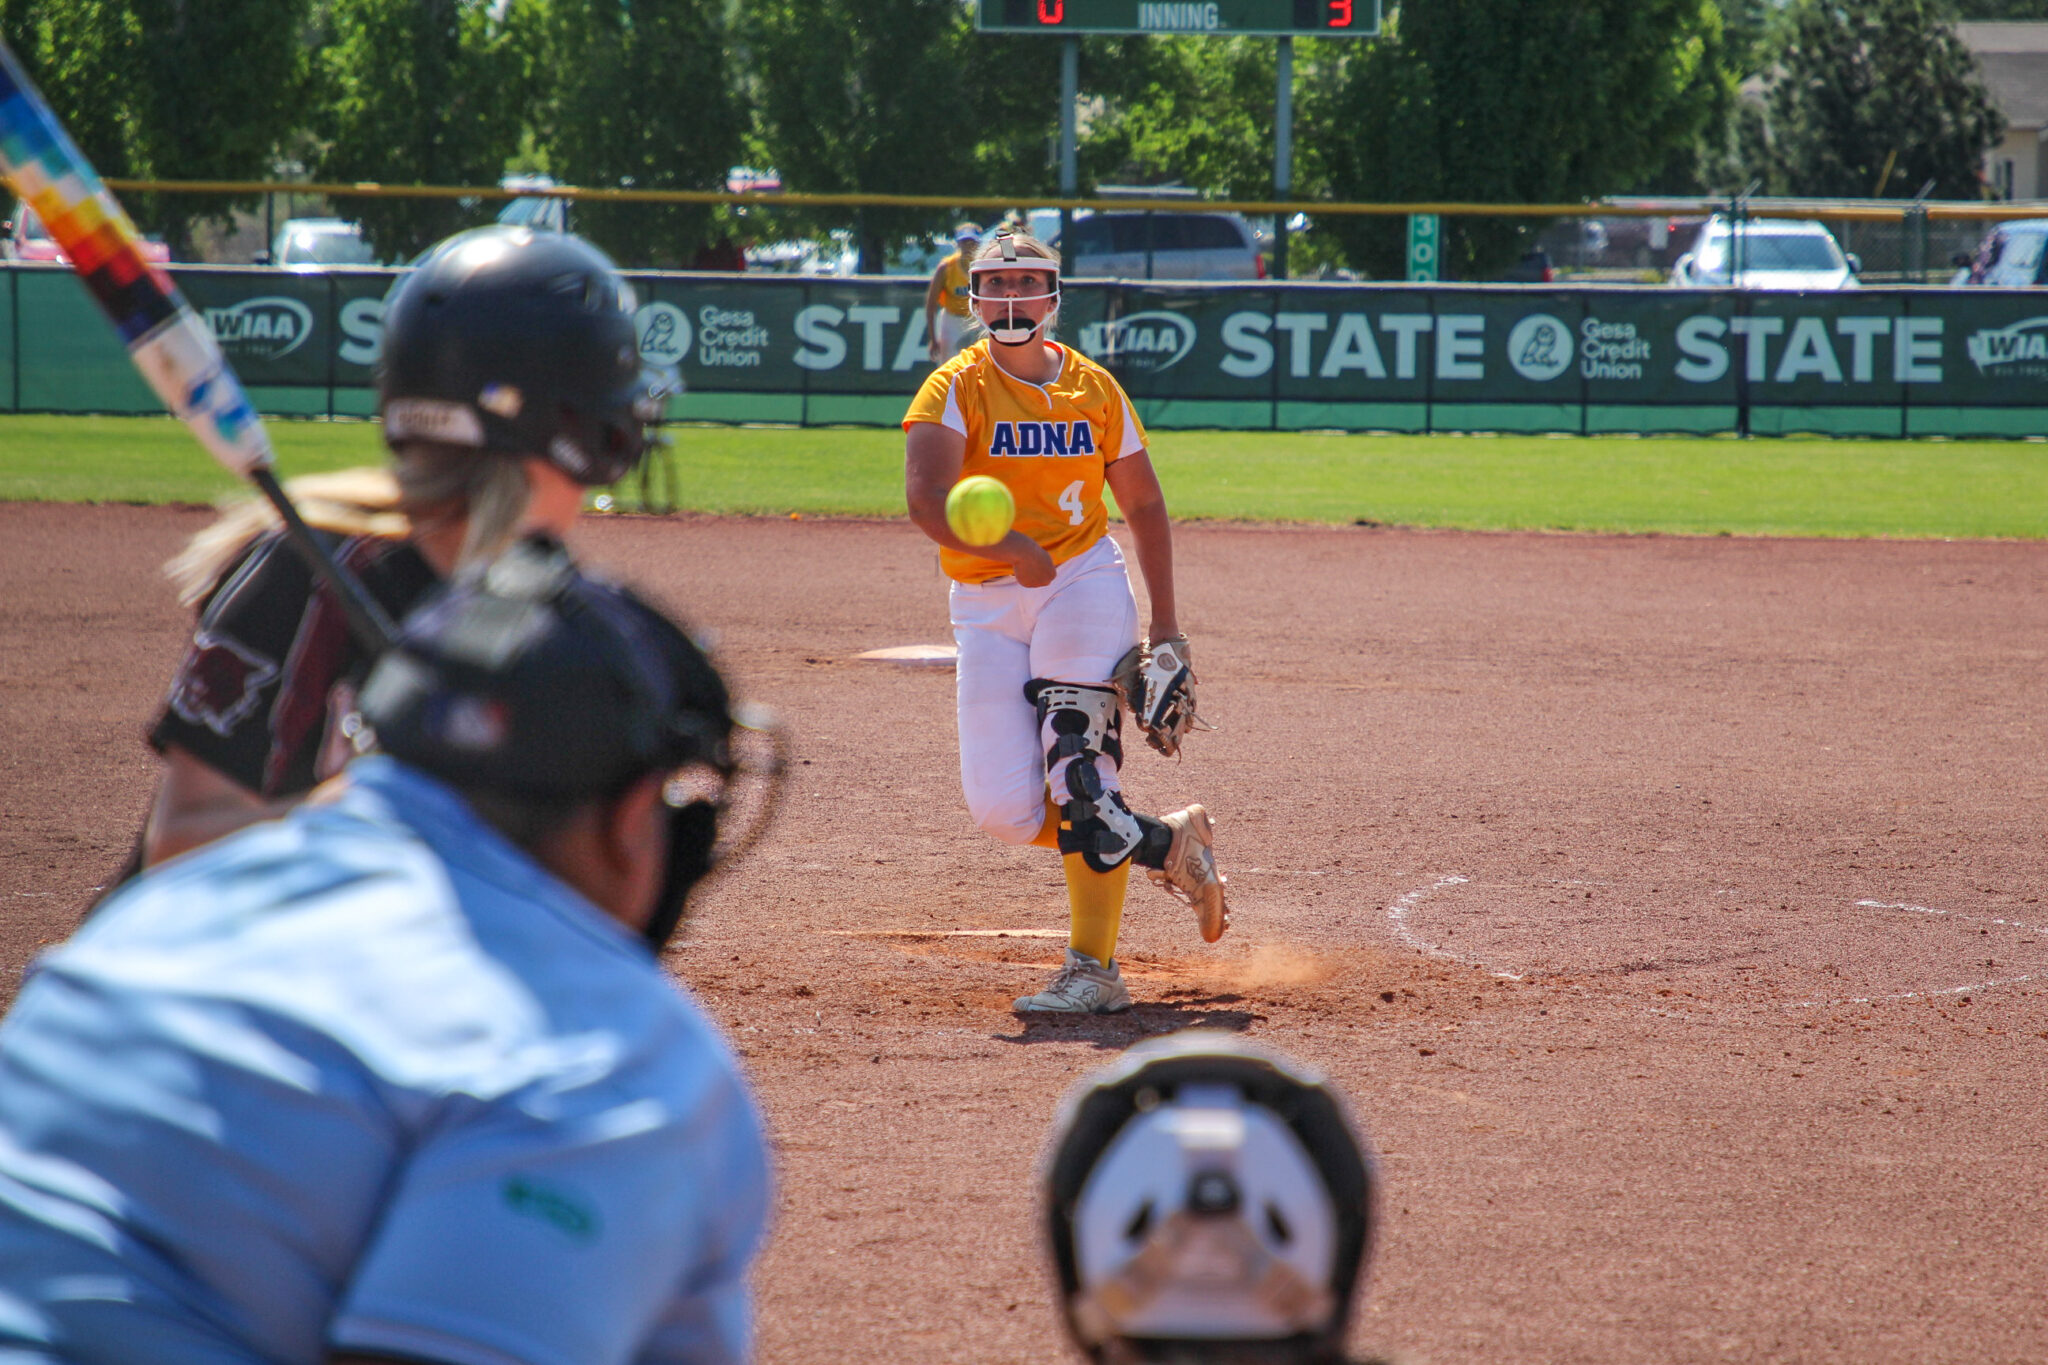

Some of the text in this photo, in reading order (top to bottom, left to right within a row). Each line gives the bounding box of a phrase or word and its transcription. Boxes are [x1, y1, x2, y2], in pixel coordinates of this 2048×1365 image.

[1138, 2, 1219, 30] INNING
[212, 312, 295, 340] WIAA
[699, 305, 754, 327] Gesa
[1581, 317, 1637, 338] Gesa
[699, 327, 769, 347] Credit
[793, 304, 938, 371] STA
[1100, 326, 1178, 353] WIAA
[1219, 311, 1486, 379] STATE
[1581, 338, 1651, 360] Credit
[1674, 314, 1944, 383] STATE
[1988, 332, 2048, 361] WIA
[700, 347, 760, 367] Union
[1581, 359, 1643, 379] Union
[988, 420, 1096, 457] ADNA
[1058, 480, 1086, 526] 4
